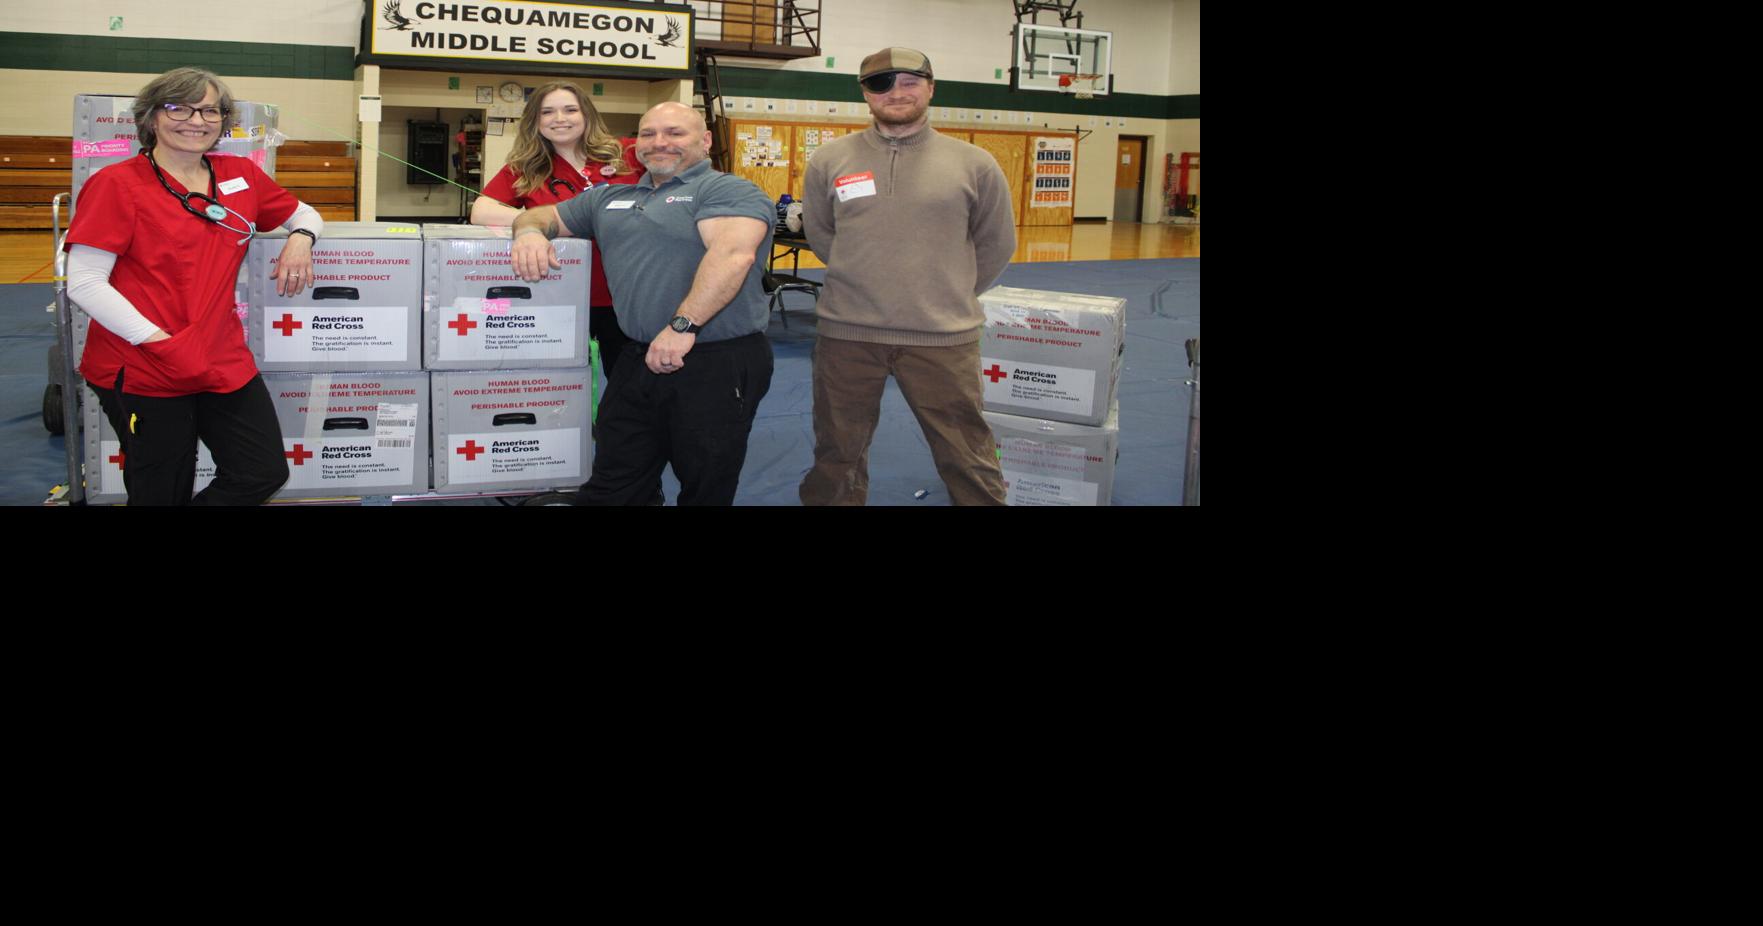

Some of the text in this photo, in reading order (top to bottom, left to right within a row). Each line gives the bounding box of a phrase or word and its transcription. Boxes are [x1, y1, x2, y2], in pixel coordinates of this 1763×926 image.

[415, 2, 655, 34] CHEQUAMEGON
[410, 31, 656, 60] MIDDLE SCHOOL
[312, 315, 364, 323] American
[1044, 326, 1101, 337] TEMPERATURE
[996, 334, 1083, 348] PERISHABLE PRODUCT
[1014, 368, 1057, 379] American
[1031, 376, 1057, 385] Cross
[352, 389, 416, 397] TEMPERATURE
[523, 384, 583, 393] TEMPERATURE
[471, 400, 566, 410] PERISHABLE PRODUCT
[492, 439, 540, 447] American
